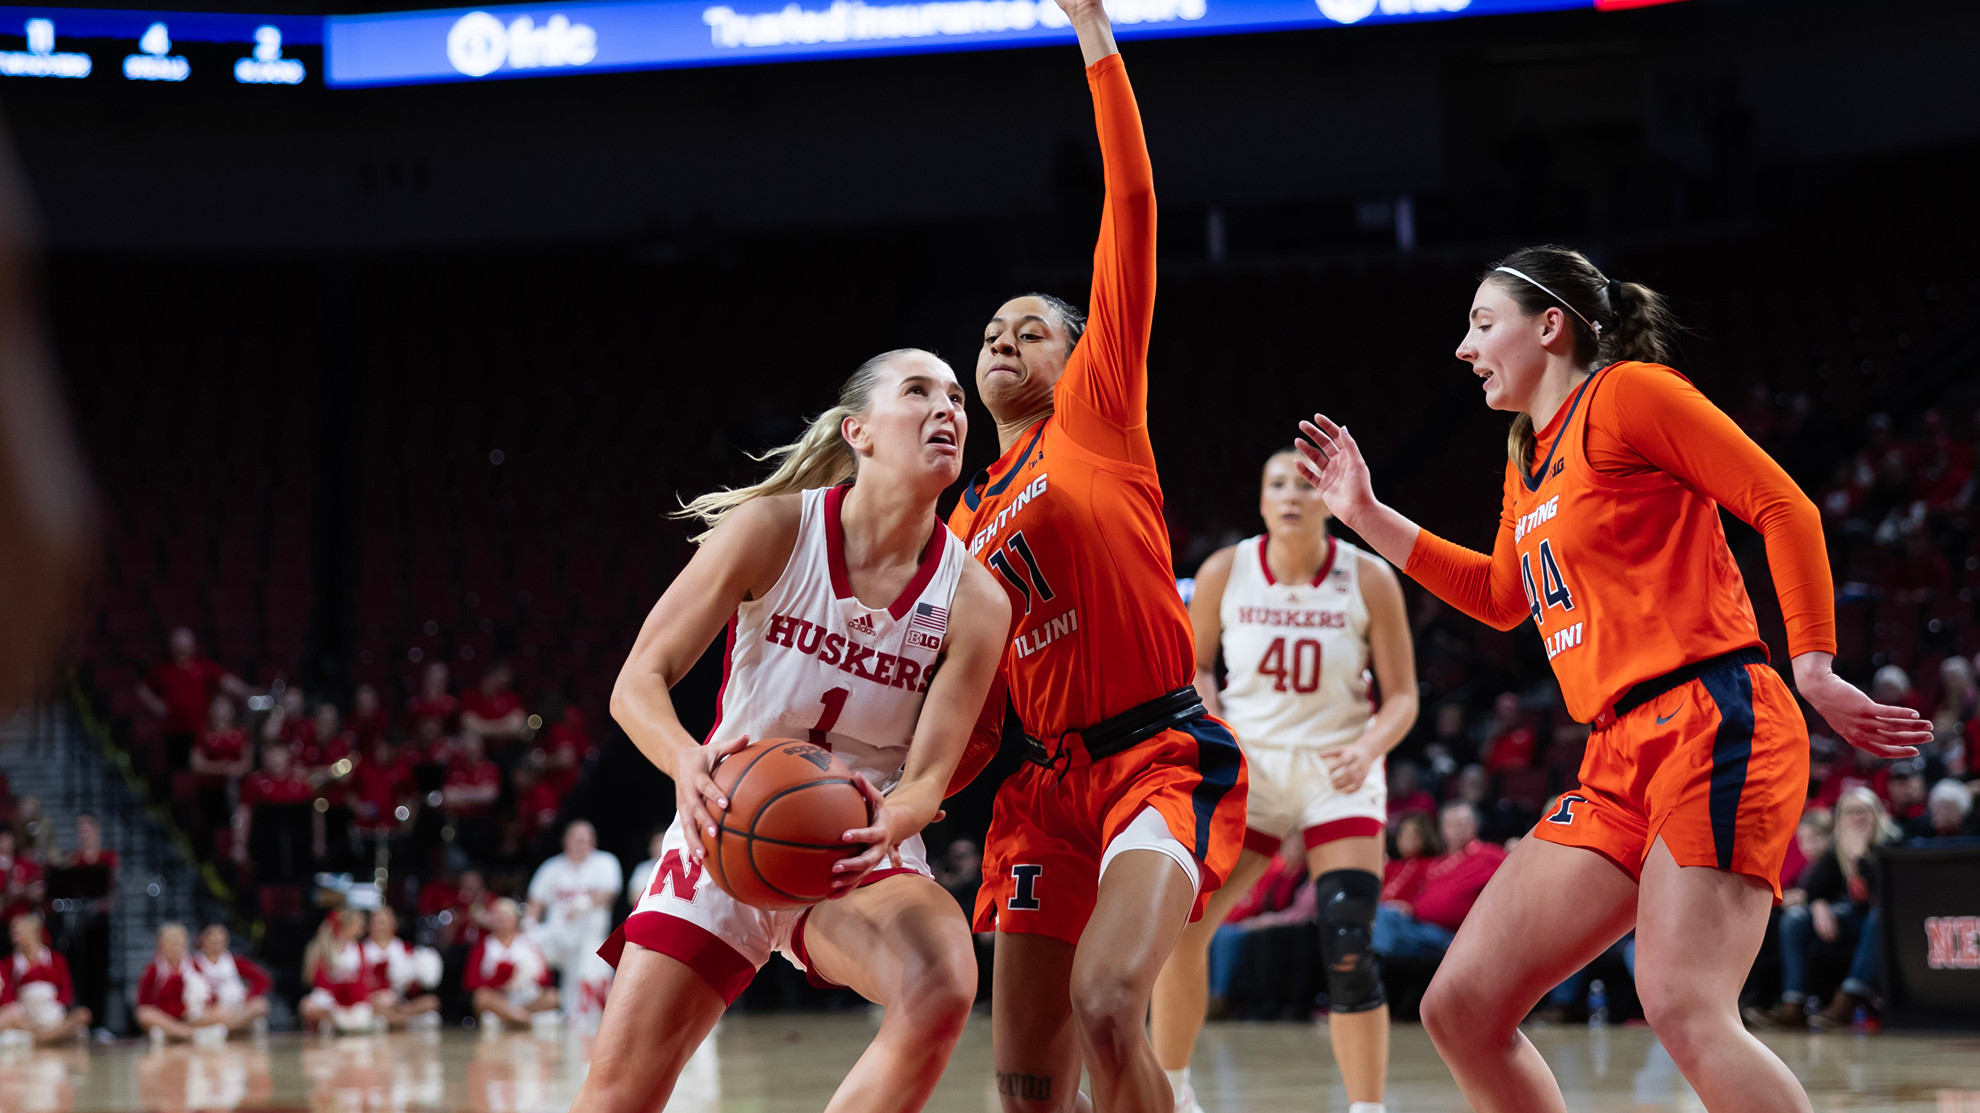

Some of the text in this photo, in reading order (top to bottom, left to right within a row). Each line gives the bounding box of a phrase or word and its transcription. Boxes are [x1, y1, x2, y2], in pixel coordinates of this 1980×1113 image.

[968, 473, 1048, 557] IGHTING
[988, 530, 1056, 616] 11
[1521, 538, 1575, 625] 44
[1014, 608, 1079, 660] ILLINI
[1238, 606, 1346, 629] HUSKERS
[1257, 636, 1322, 694] 40
[809, 686, 850, 753] 1
[648, 848, 705, 905] N
[1008, 863, 1043, 911] I
